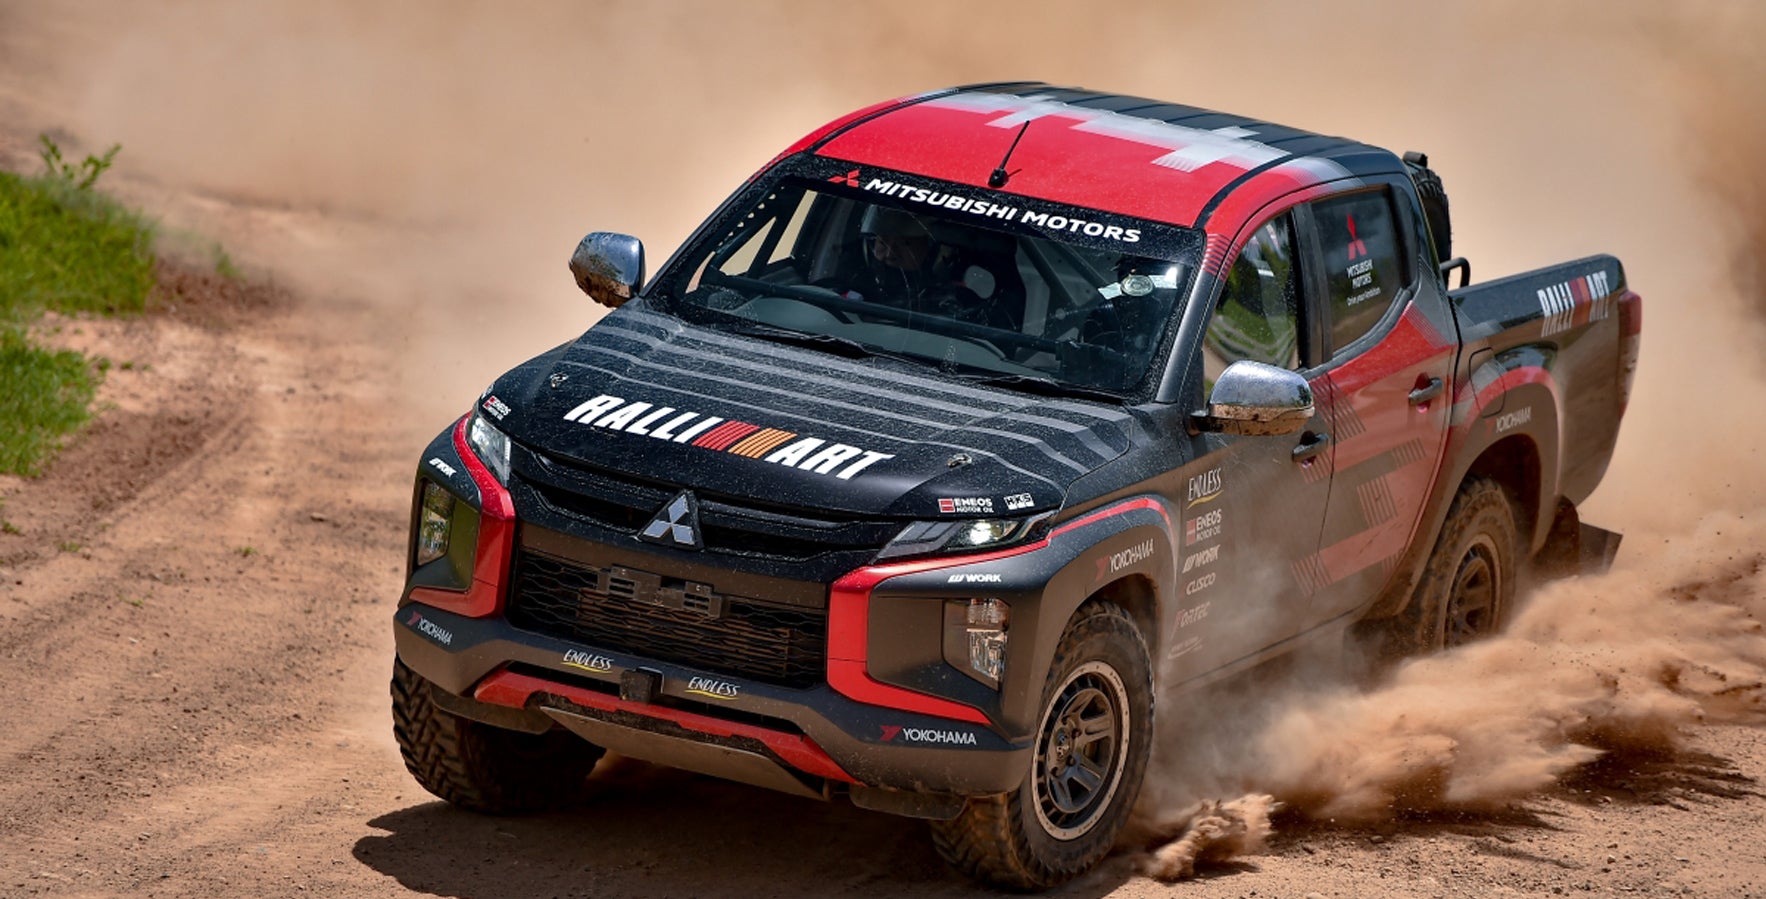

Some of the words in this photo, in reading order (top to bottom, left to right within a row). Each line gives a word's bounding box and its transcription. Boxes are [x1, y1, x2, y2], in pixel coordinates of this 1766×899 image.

[864, 178, 1017, 221] MITSUBISHI
[1021, 210, 1141, 243] MOTORS
[1496, 406, 1532, 433] YOKOHAMA
[563, 394, 724, 444] RALLI
[764, 437, 896, 480] ART
[1188, 467, 1222, 501] ENDLESS
[954, 498, 993, 507] ENEOS
[1196, 508, 1222, 531] ENEOS
[1109, 538, 1154, 573] YOKOHAMA
[966, 574, 1002, 583] WORK
[1186, 572, 1216, 595] CUSCO
[418, 617, 453, 645] YOKOHAMA
[563, 649, 615, 671] ENDLESS
[688, 676, 742, 697] ENDLESS
[902, 728, 977, 745] YOKOHAMA
